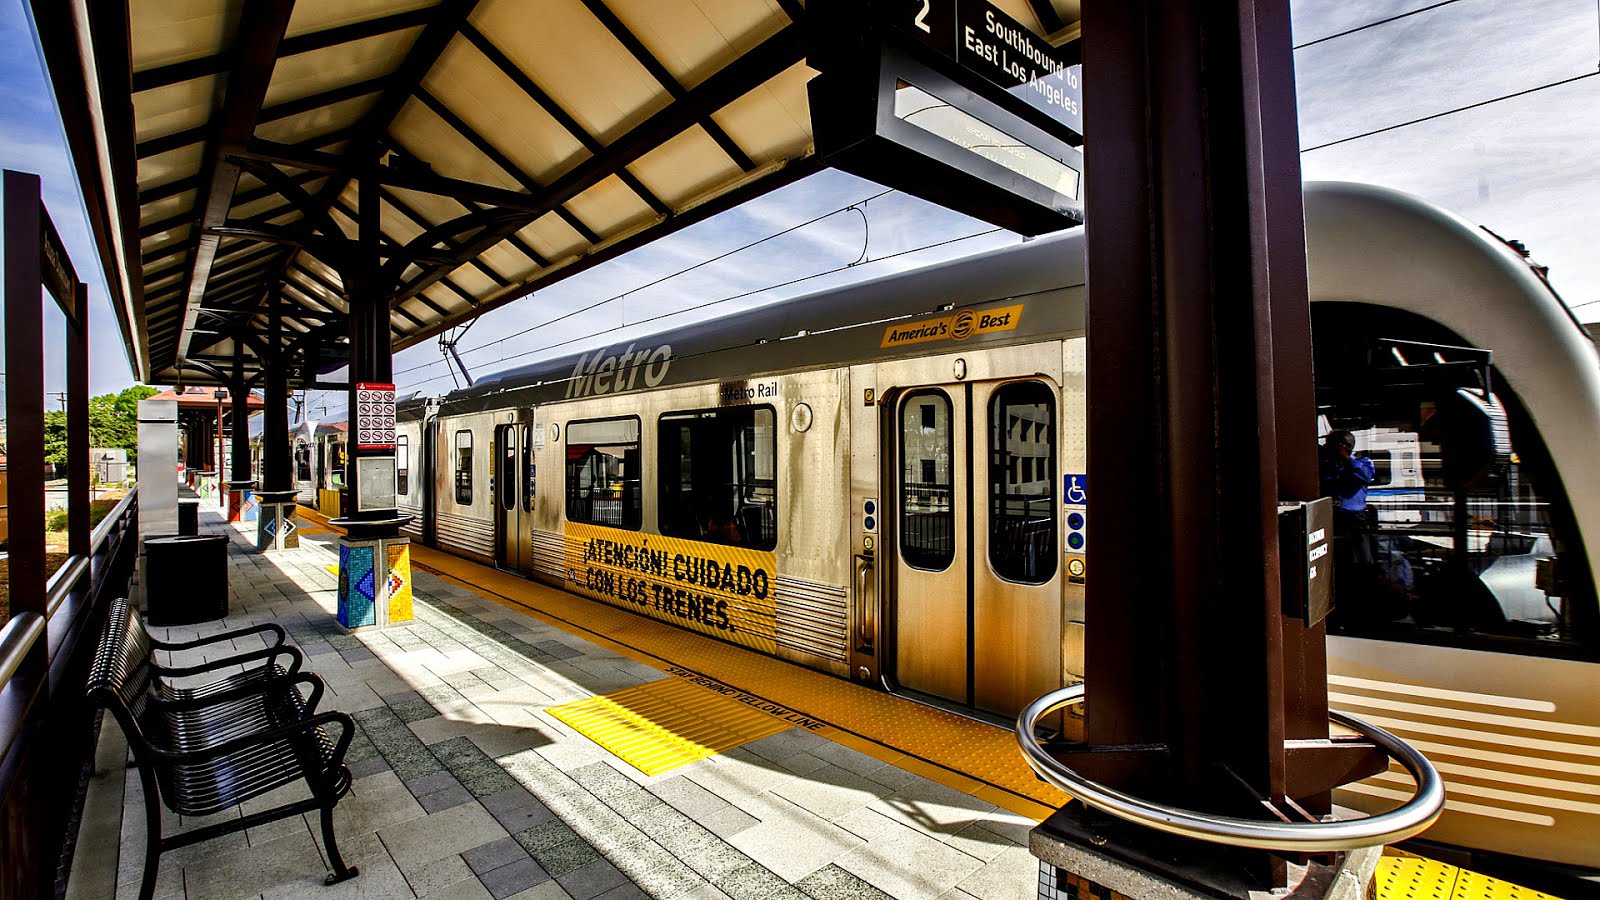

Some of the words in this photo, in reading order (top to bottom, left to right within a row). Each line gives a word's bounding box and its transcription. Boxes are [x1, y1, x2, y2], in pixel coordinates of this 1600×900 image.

[914, 0, 931, 34] 2
[965, 25, 999, 67] East
[1003, 50, 1027, 83] Los
[1029, 69, 1078, 116] Angeles
[985, 10, 1063, 79] Southbound
[1066, 69, 1078, 90] to
[888, 322, 947, 343] America's
[979, 312, 1011, 329] Best
[293, 368, 301, 377] 2
[564, 343, 672, 399] Metro
[724, 384, 755, 401] Metro
[758, 381, 778, 398] Rail
[586, 567, 614, 597] CON
[618, 574, 648, 606] LOS
[652, 583, 736, 633] TRENES.
[673, 553, 769, 600] CUIDADO
[665, 666, 693, 679] STAY
[690, 676, 735, 697] BEHIND
[732, 692, 786, 716] YELLOW
[784, 713, 826, 731] LINE
